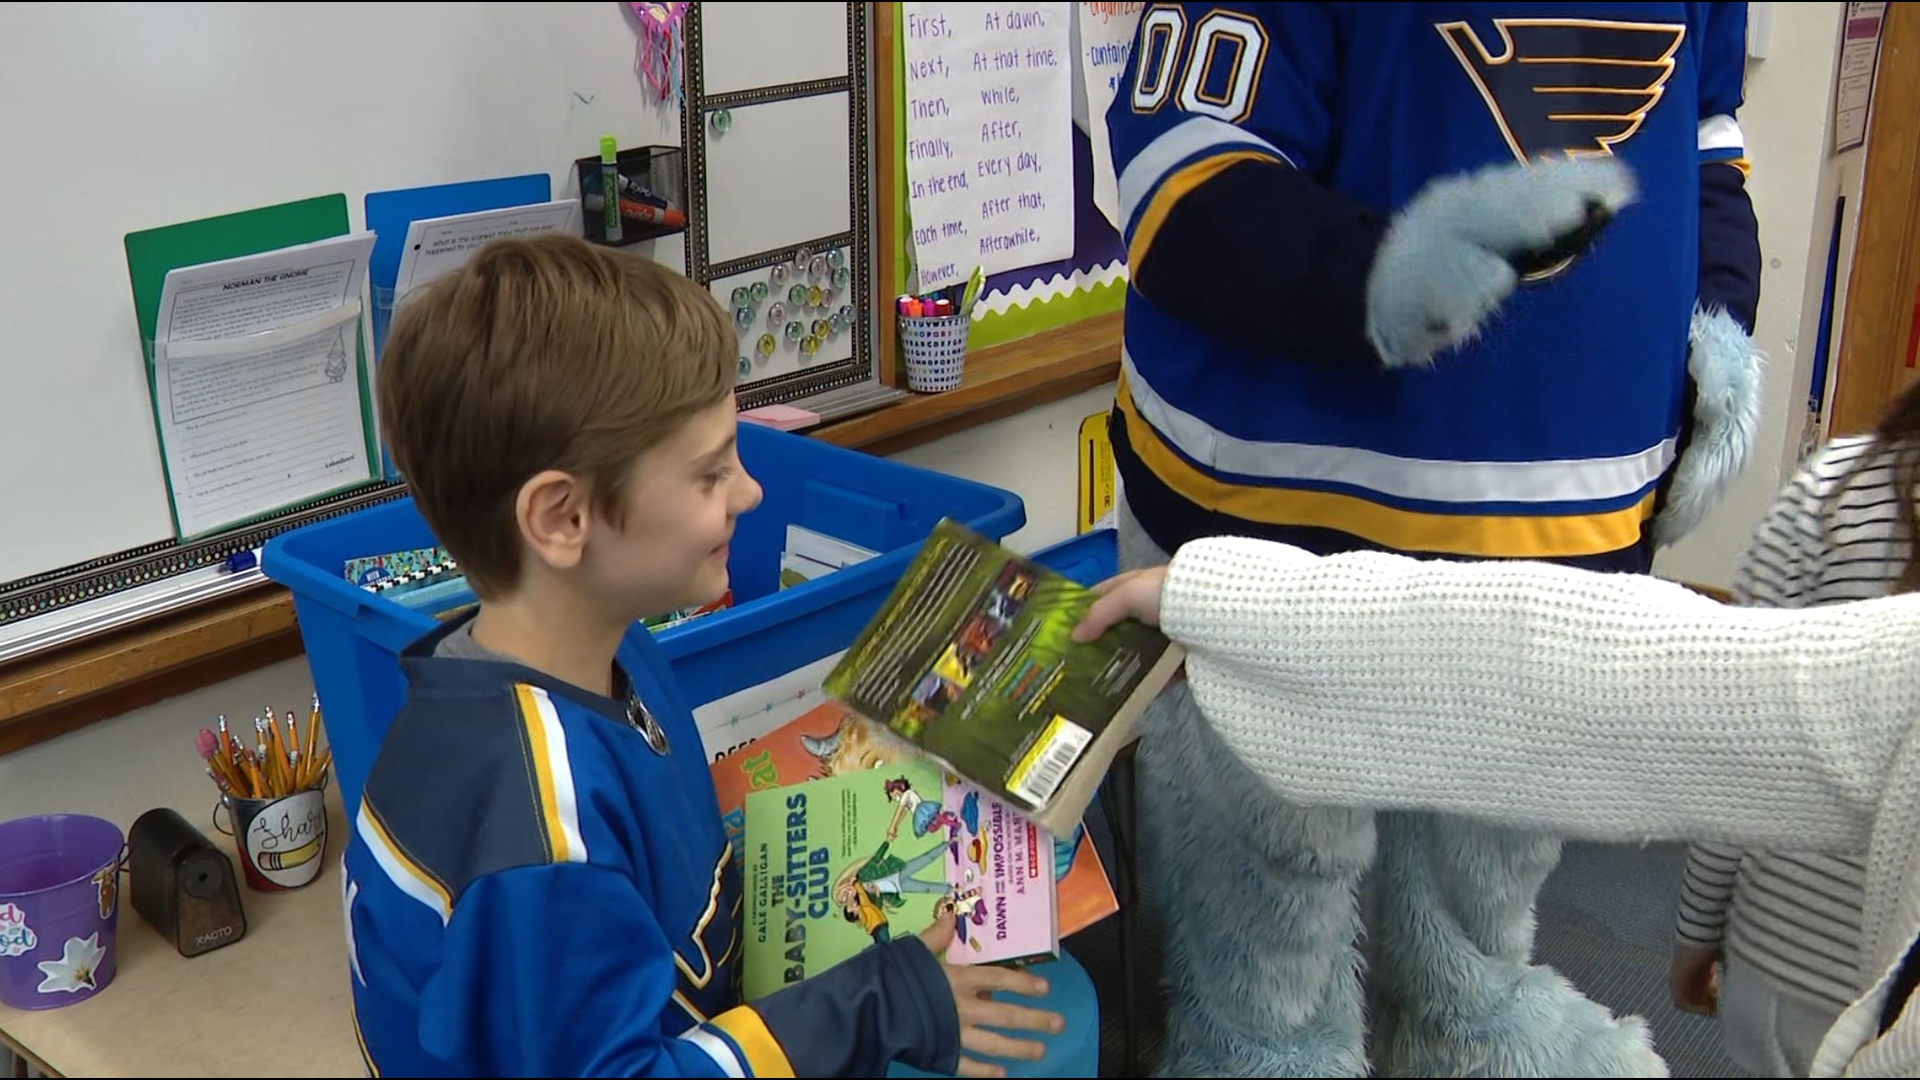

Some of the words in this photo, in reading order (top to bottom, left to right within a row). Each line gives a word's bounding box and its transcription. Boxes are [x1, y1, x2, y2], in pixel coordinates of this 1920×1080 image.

[909, 13, 952, 38] First,
[985, 12, 1000, 30] At
[1006, 10, 1045, 28] dawn,
[910, 57, 950, 80] Next,
[973, 53, 987, 71] At
[993, 49, 1019, 70] that
[1025, 47, 1058, 68] time,
[1131, 2, 1270, 124] 00
[911, 97, 950, 119] Then,
[981, 86, 1020, 105] While,
[981, 120, 1022, 143] After,
[909, 139, 954, 161] Finally,
[978, 158, 1010, 178] Every
[1017, 152, 1042, 173] day,
[911, 180, 925, 199] In
[928, 176, 945, 195] the
[948, 171, 969, 190] end,
[982, 198, 1010, 219] After
[1018, 192, 1046, 210] that,
[915, 226, 937, 246] Each
[942, 219, 968, 238] time,
[222, 277, 261, 291] NORMAN
[264, 274, 278, 284] THE
[279, 269, 309, 281] GNOME
[920, 263, 959, 287] However,
[992, 802, 1004, 878] IMPOSSIBLE
[759, 843, 769, 907] GALLIGAN
[784, 792, 807, 984] BABY-SITTERS
[808, 847, 830, 919] CLUB
[1015, 866, 1025, 895] ANN
[772, 875, 784, 908] THE
[758, 911, 767, 943] GALE
[996, 896, 1007, 940] DAWN
